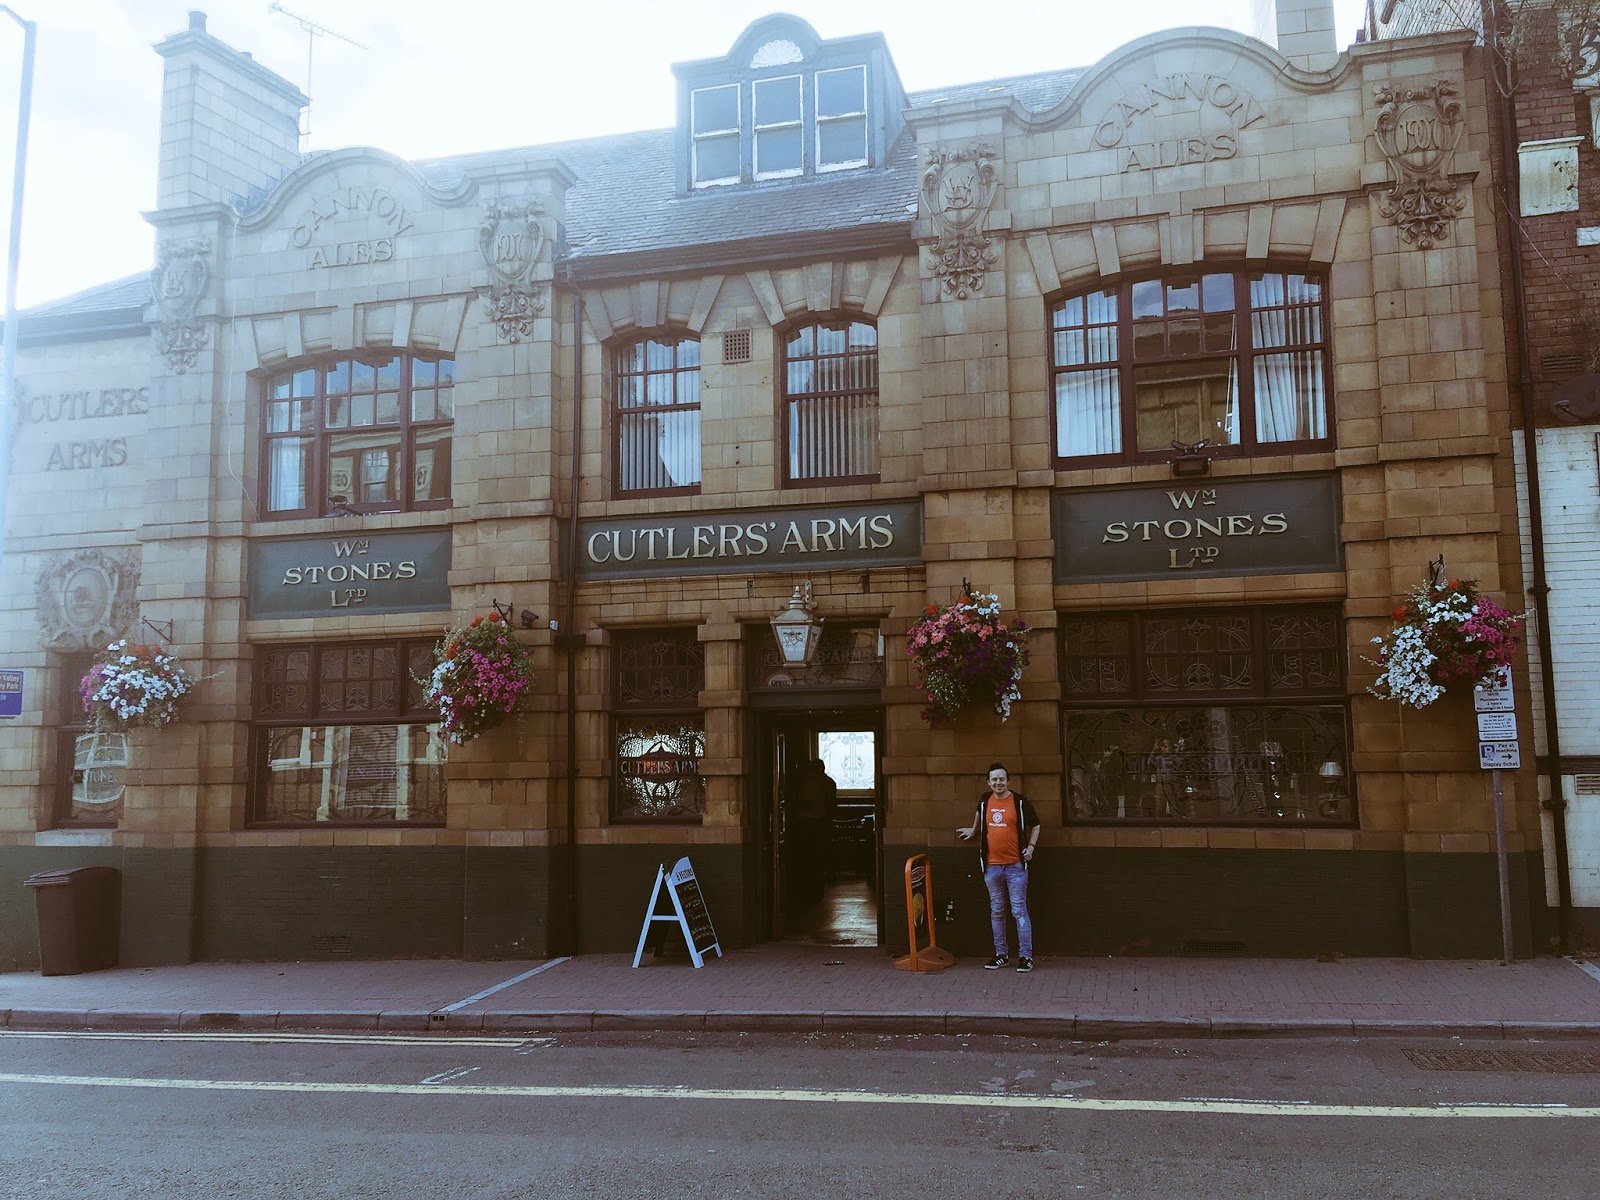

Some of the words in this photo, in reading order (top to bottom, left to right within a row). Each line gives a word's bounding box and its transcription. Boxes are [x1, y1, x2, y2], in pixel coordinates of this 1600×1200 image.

[1094, 74, 1265, 148] CANNON
[1121, 134, 1239, 174] ALES
[293, 186, 414, 249] CANNON
[308, 239, 394, 271] ALES
[31, 387, 149, 423] CUTLERS
[45, 437, 128, 471] ARMS
[586, 521, 777, 564] CUTLERS'
[779, 514, 894, 555] ARMS
[1102, 512, 1288, 543] STONES
[282, 560, 417, 586] STONES
[674, 760, 699, 774] ARM
[1484, 746, 1494, 758] P
